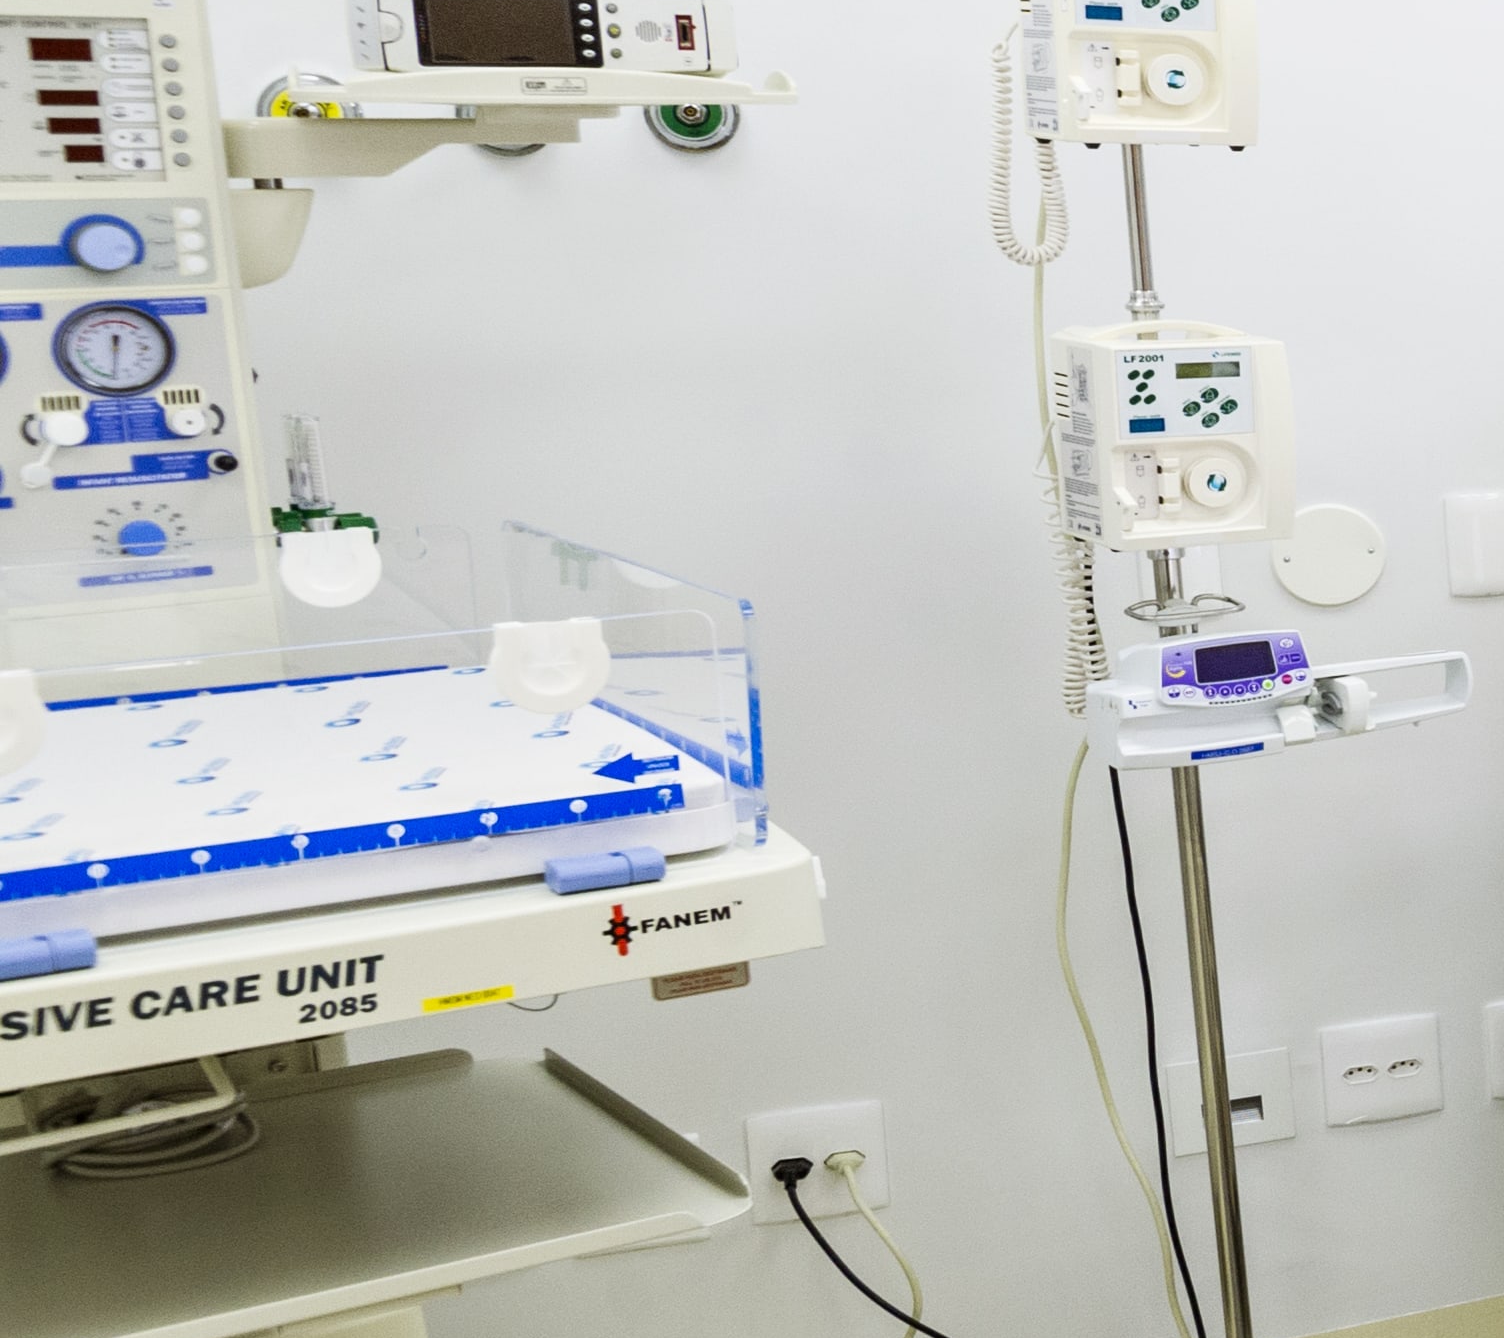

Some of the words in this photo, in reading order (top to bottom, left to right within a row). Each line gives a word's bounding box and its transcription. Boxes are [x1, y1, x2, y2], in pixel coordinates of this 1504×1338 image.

[1138, 354, 1164, 363] 2001
[130, 974, 261, 1021] CARE
[276, 953, 385, 998] UNIT
[298, 992, 379, 1024] 2085
